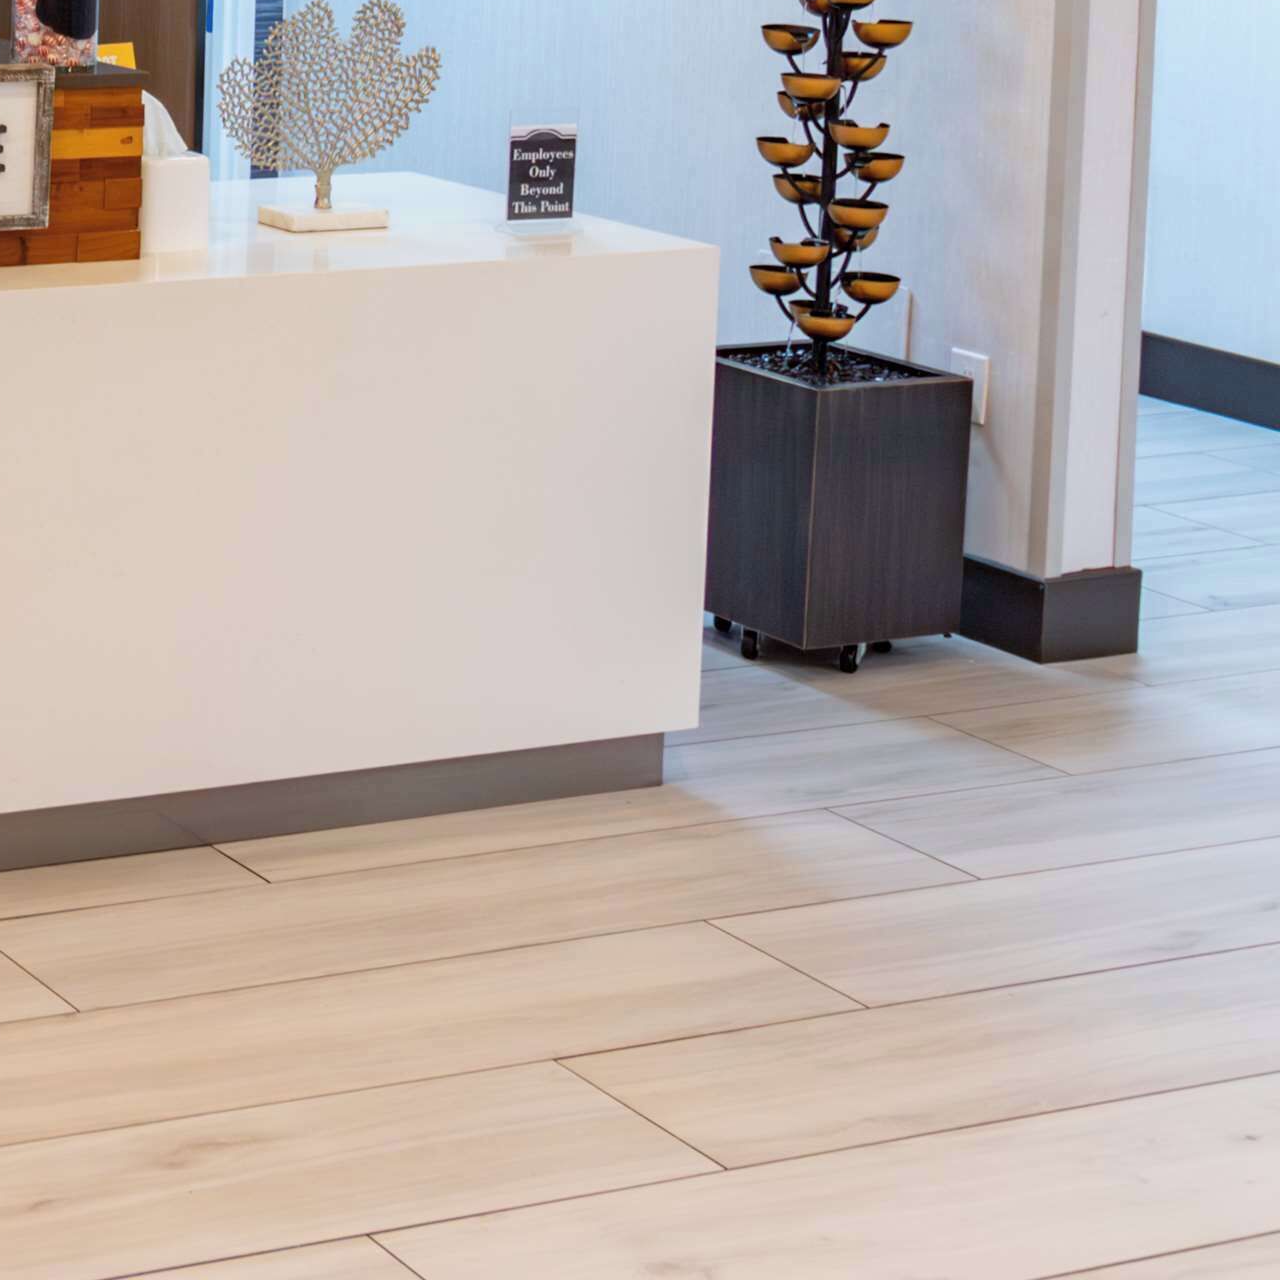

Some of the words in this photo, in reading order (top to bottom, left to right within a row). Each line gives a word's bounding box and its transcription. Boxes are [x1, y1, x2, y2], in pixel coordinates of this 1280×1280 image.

[512, 148, 574, 164] Employees
[529, 165, 557, 180] Only
[520, 182, 564, 198] Beyond
[512, 200, 537, 213] This
[540, 200, 570, 213] Point
